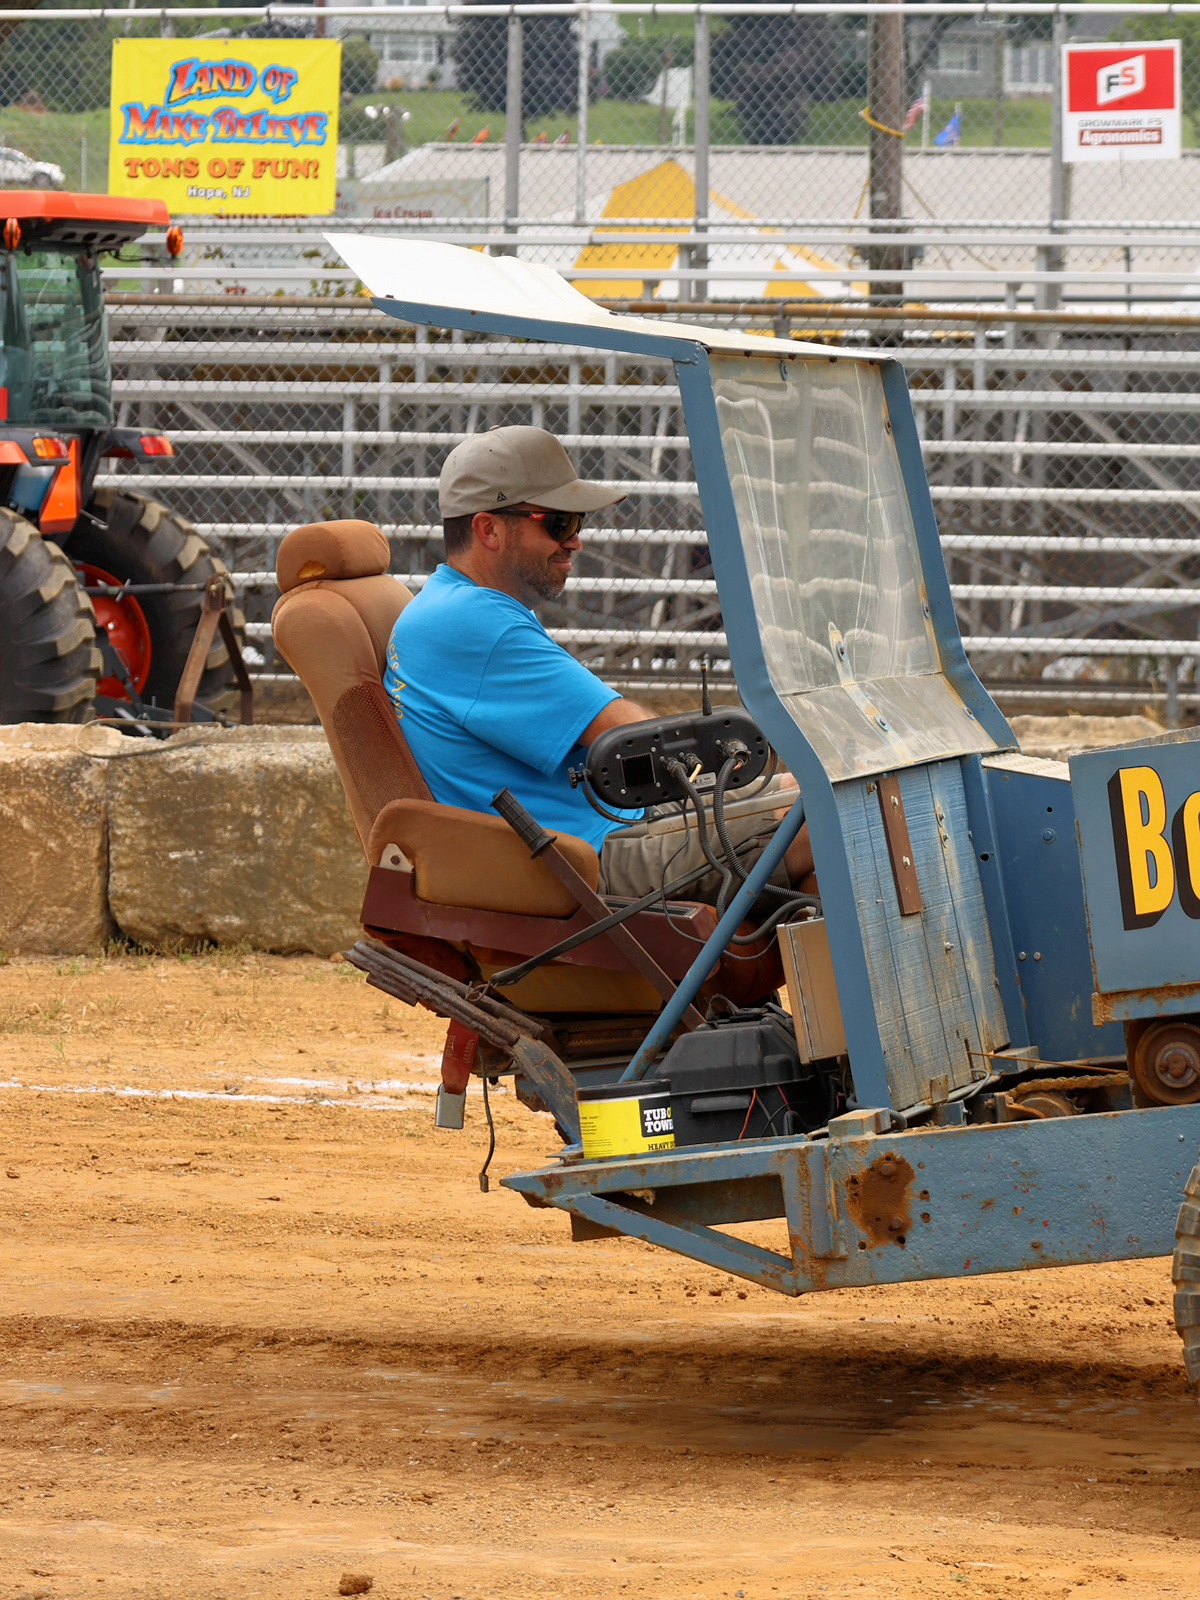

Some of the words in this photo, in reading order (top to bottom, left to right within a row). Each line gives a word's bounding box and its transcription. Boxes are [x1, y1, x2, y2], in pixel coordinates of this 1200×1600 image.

[1106, 66, 1136, 93] FS
[1078, 118, 1143, 128] GROWMARK
[1081, 128, 1160, 145] Agronomics
[124, 157, 199, 178] TONS
[207, 157, 245, 178] OF
[251, 157, 320, 179] FUN!
[187, 186, 227, 199] Hope,
[232, 186, 250, 197] NJ
